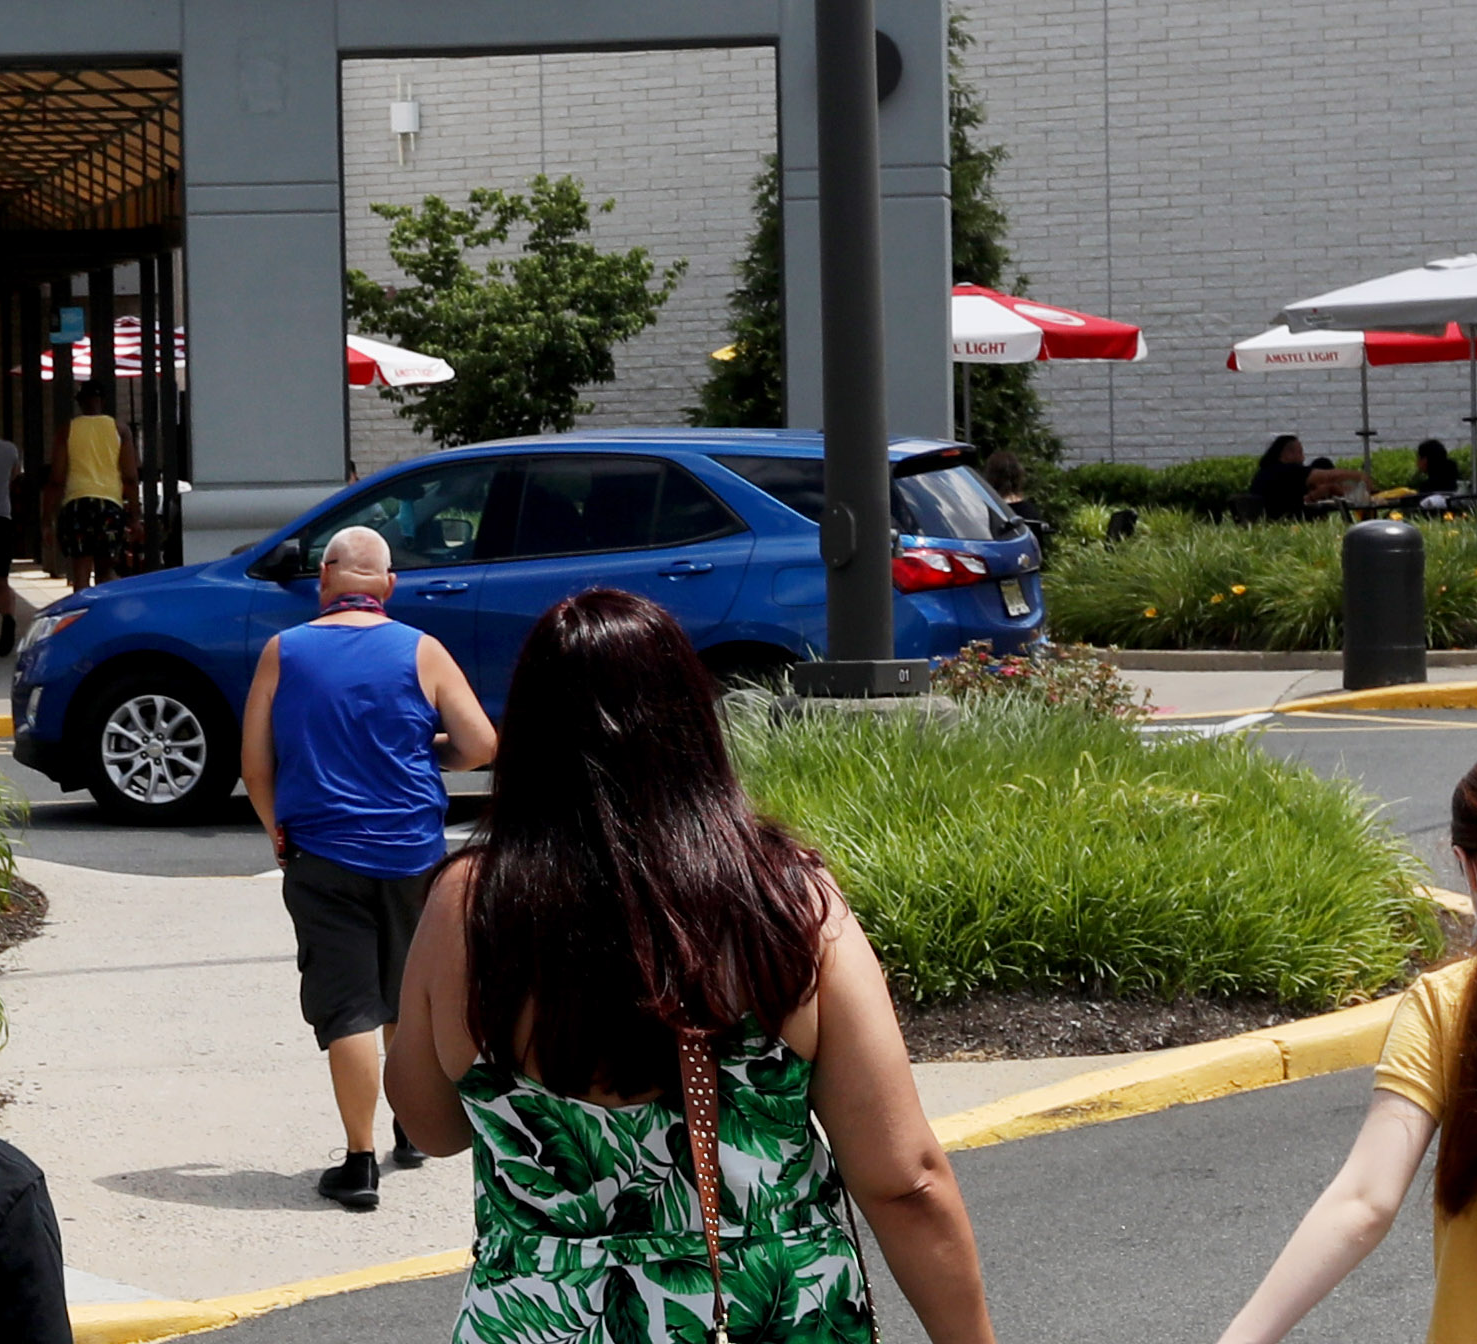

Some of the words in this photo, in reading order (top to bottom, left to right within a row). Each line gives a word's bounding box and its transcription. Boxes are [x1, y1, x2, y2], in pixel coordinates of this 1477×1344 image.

[965, 342, 1007, 355] LIGHT
[1265, 352, 1305, 364] AMSTEL
[1307, 351, 1339, 362] LIGHT
[898, 668, 910, 683] 01
